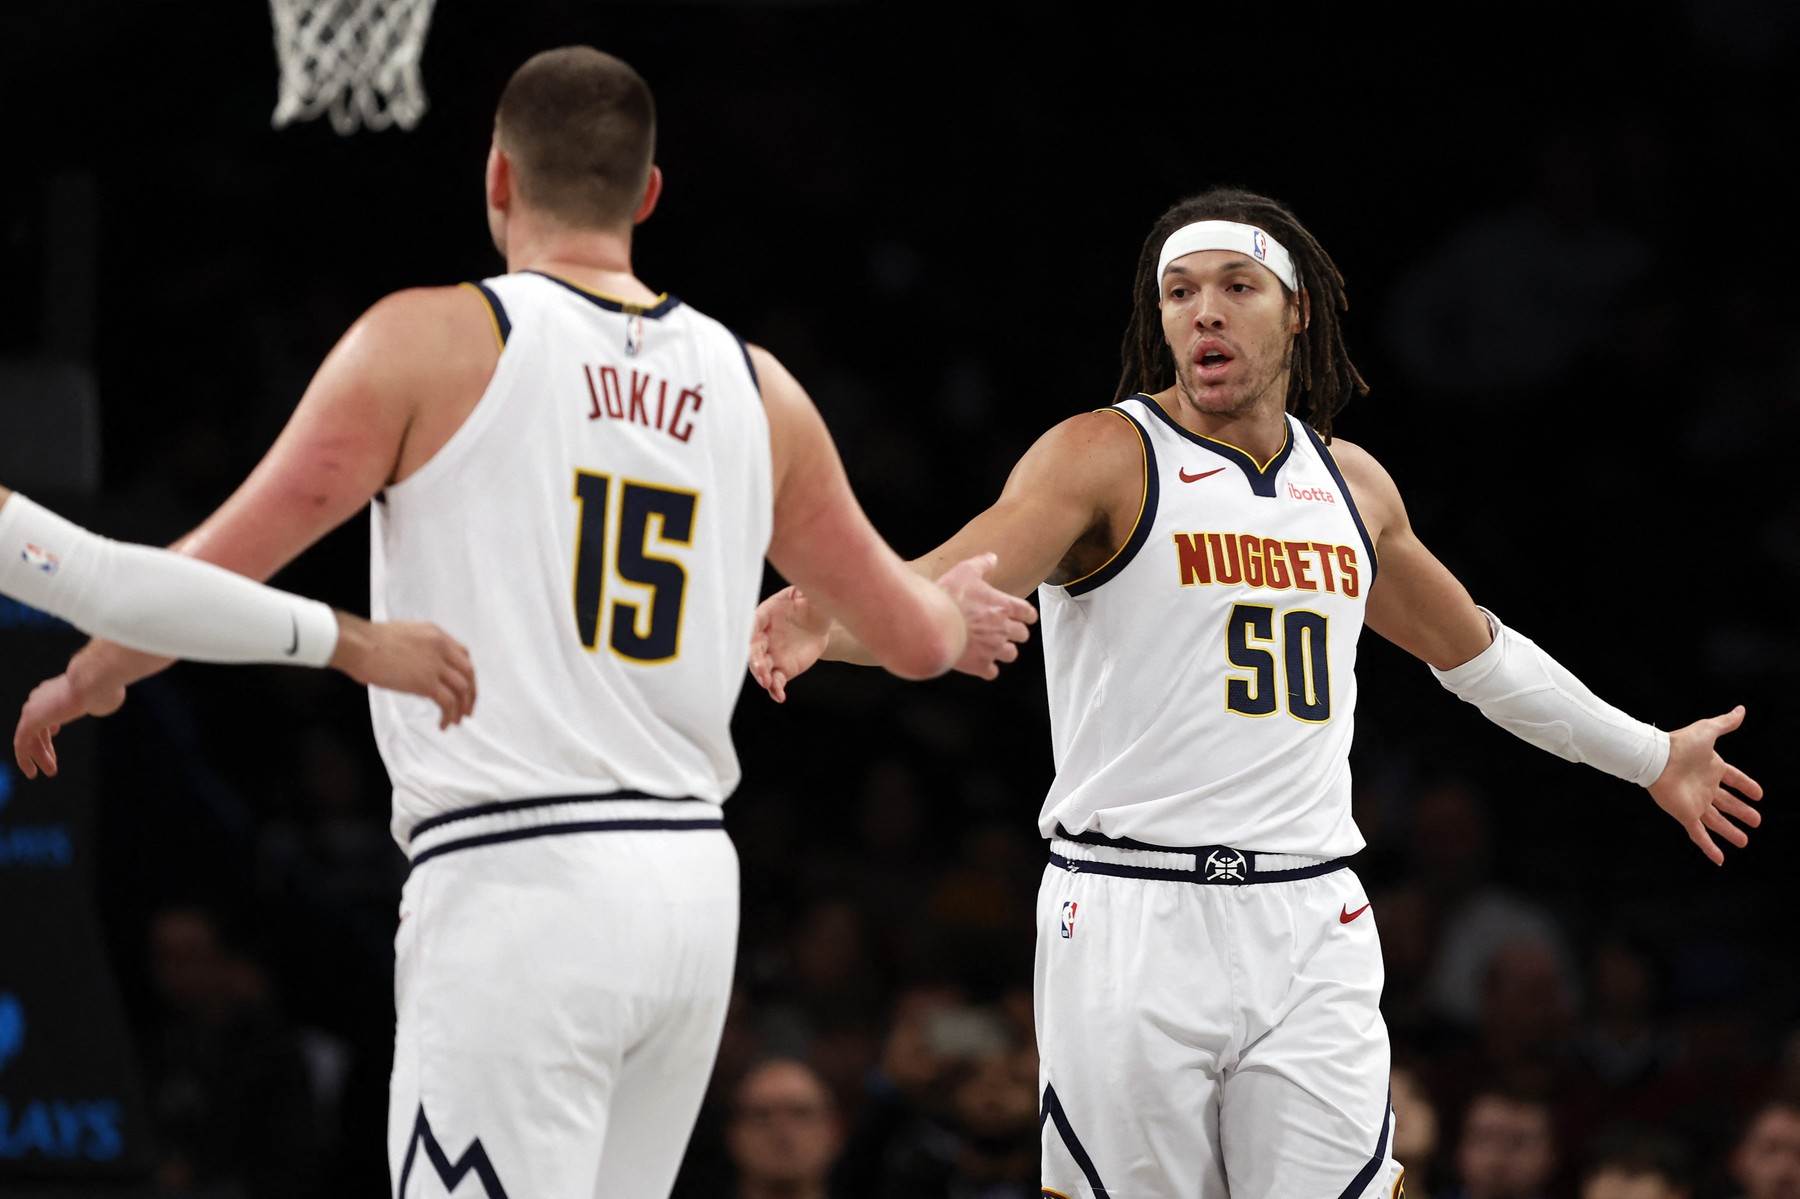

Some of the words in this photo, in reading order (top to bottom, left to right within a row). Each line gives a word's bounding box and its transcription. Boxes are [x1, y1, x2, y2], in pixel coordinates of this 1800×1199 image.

[585, 365, 703, 442] JOKIĆ
[1287, 482, 1336, 504] ibotta
[574, 468, 701, 664] 15
[1173, 532, 1360, 599] NUGGETS
[1225, 602, 1331, 724] 50
